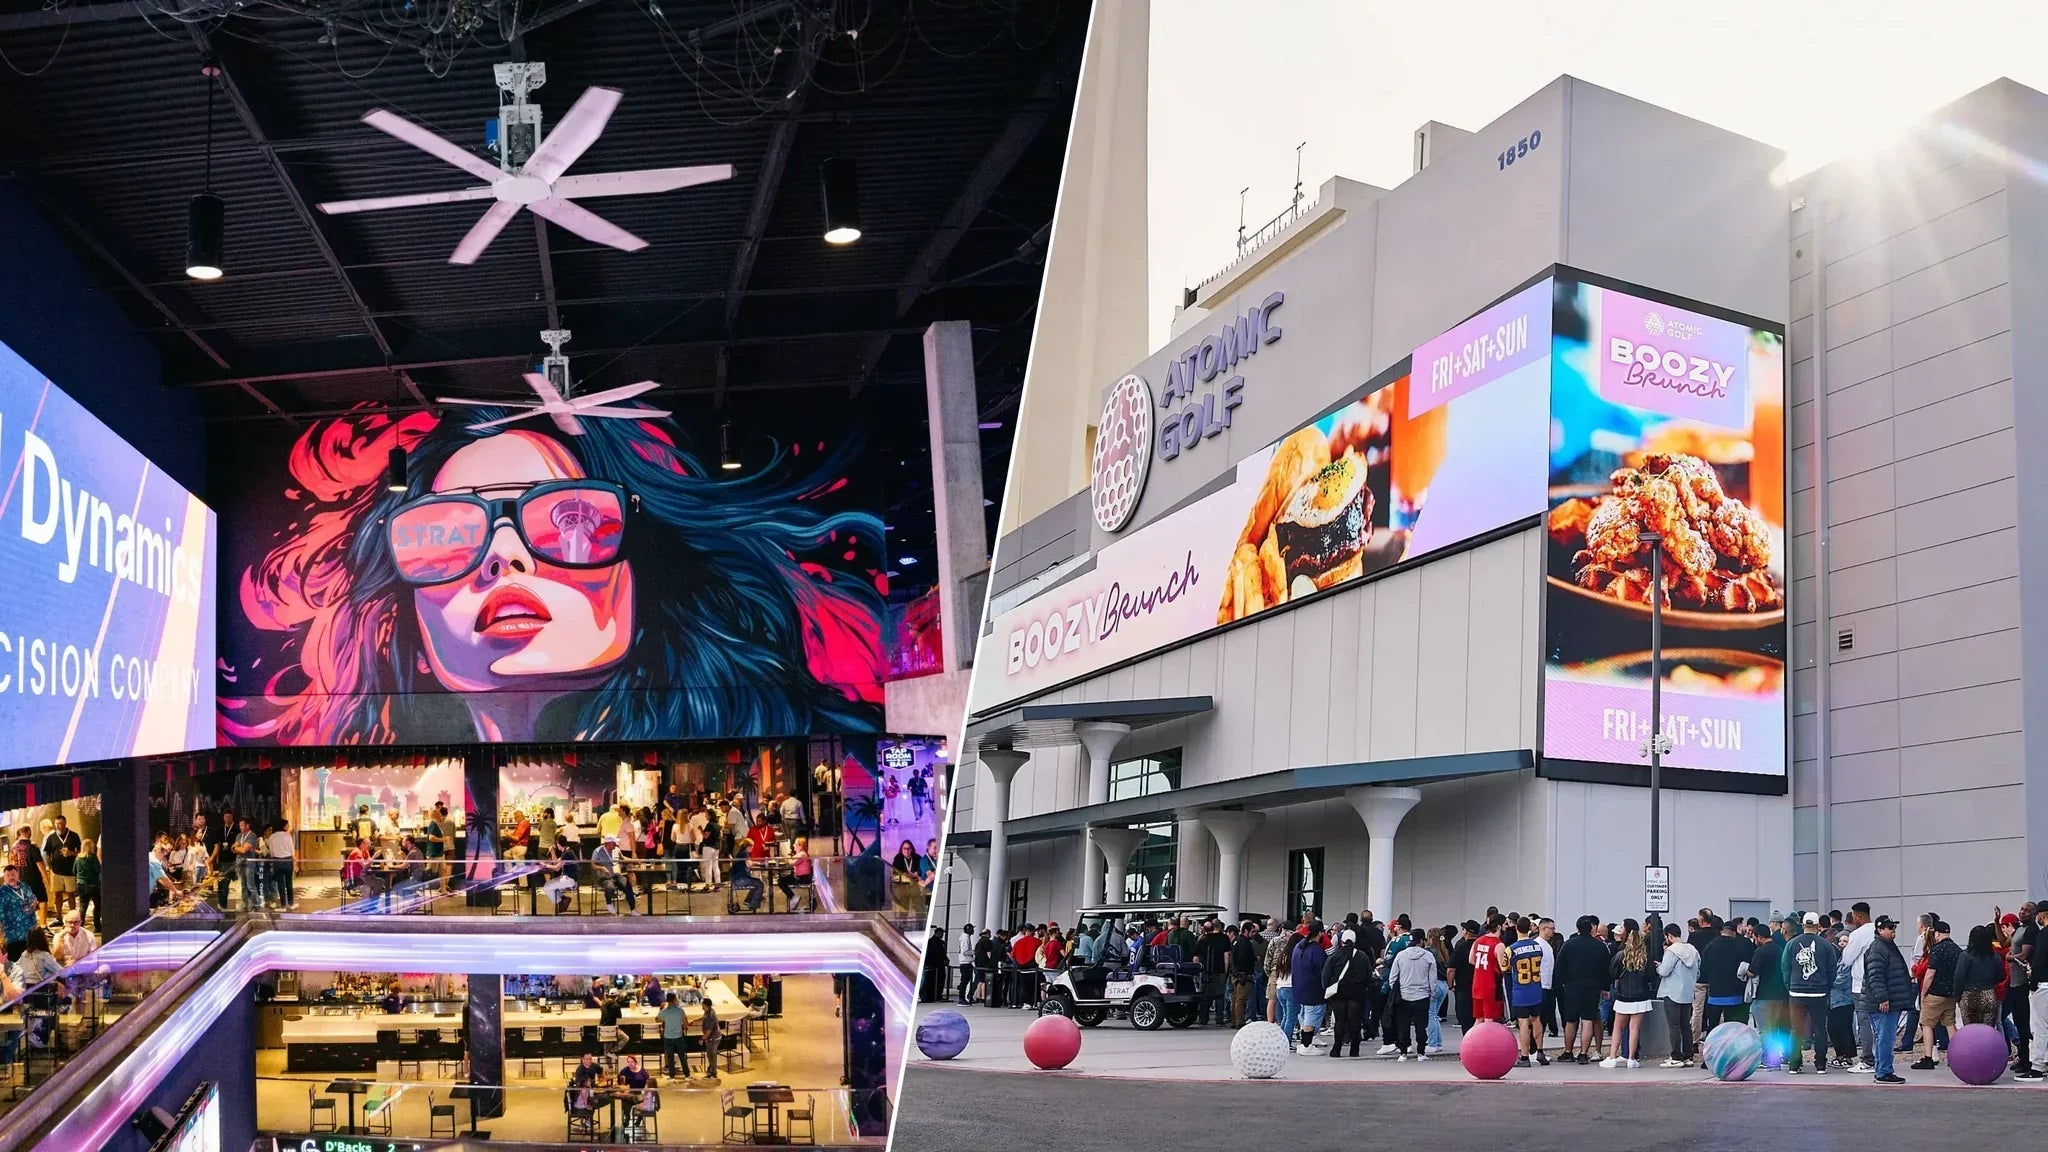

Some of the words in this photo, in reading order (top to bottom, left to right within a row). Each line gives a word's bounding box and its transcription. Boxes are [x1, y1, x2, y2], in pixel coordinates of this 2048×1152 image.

[1498, 130, 1541, 171] 1850
[1667, 320, 1703, 336] ATOMIC
[1667, 328, 1693, 341] GOLF
[1159, 291, 1284, 409] ATOMIC
[1610, 337, 1735, 388] BOOZY
[1157, 376, 1244, 462] GOLF
[22, 430, 202, 607] Dynamics
[397, 524, 480, 547] STRAT
[1008, 591, 1104, 676] BOOZY
[111, 654, 199, 705] COMPANY
[1475, 952, 1488, 970] 14
[1516, 956, 1541, 985] 85
[325, 1141, 372, 1152] D'Backs
[388, 1144, 395, 1152] 2
